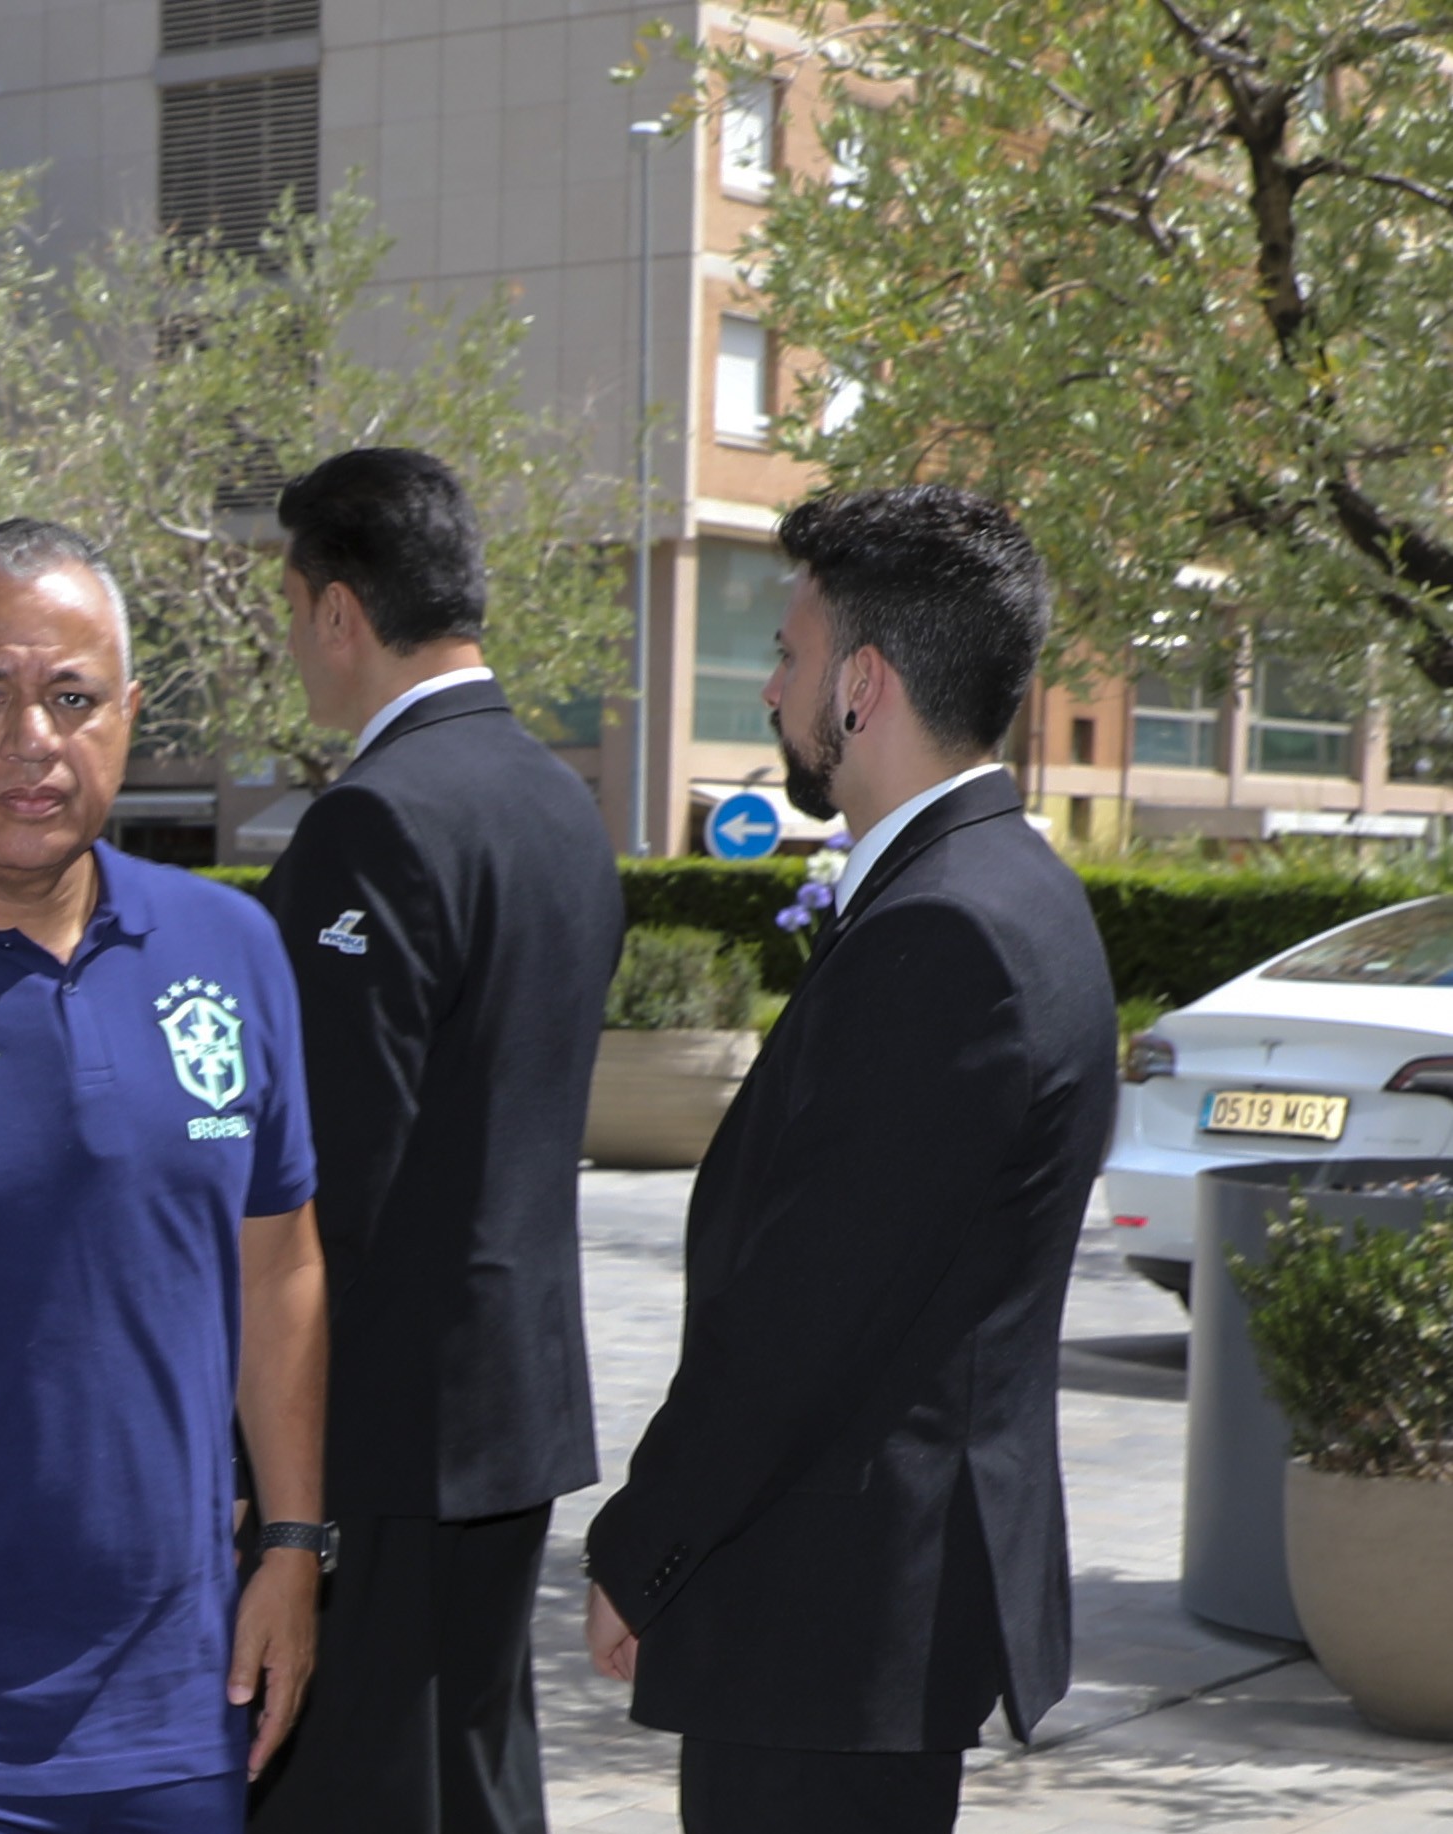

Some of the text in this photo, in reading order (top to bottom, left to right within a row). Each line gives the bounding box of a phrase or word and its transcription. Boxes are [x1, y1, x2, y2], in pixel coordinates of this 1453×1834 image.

[187, 1115, 250, 1139] BRASIL
[1212, 1096, 1337, 1132] 0519 MGX
